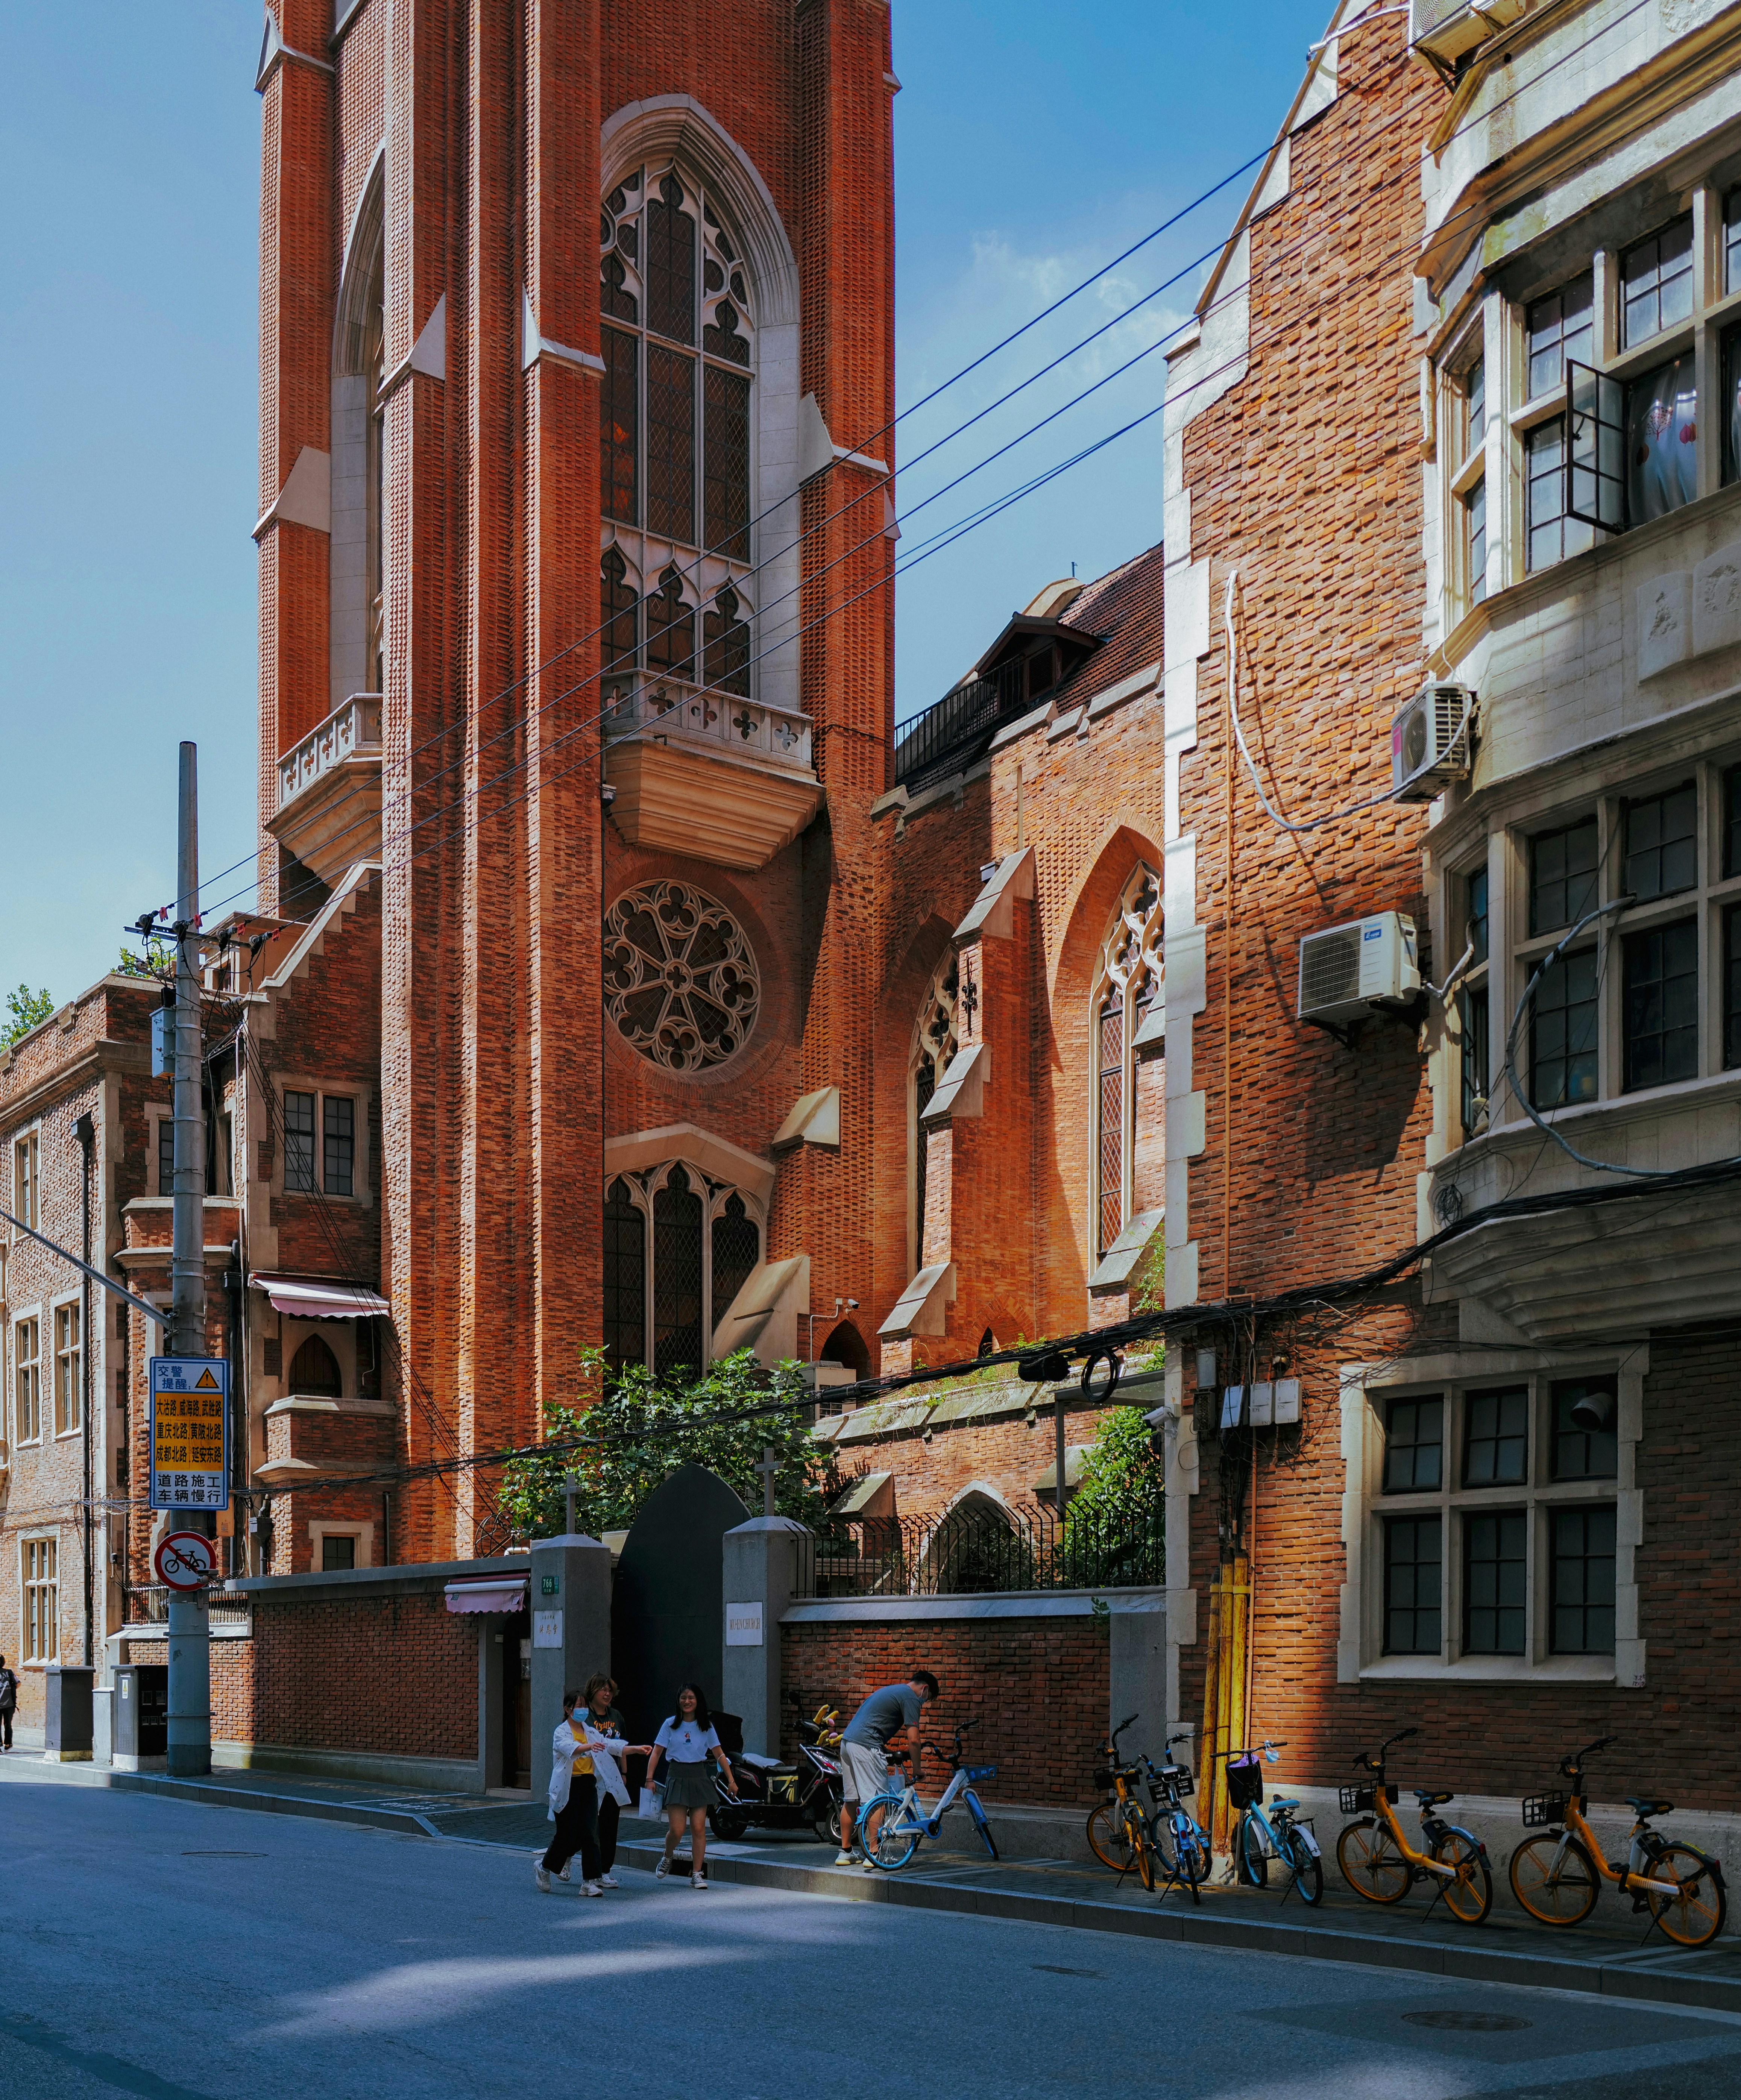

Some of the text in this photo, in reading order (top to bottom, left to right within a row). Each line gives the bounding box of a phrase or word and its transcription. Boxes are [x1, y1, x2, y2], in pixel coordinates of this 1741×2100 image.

[158, 1366, 182, 1377] 交警
[158, 1474, 220, 1487] 道路施工
[158, 1489, 221, 1502] 车辆慢行
[543, 1579, 552, 1588] 766
[730, 1618, 760, 1630] MU-EN CHURCH
